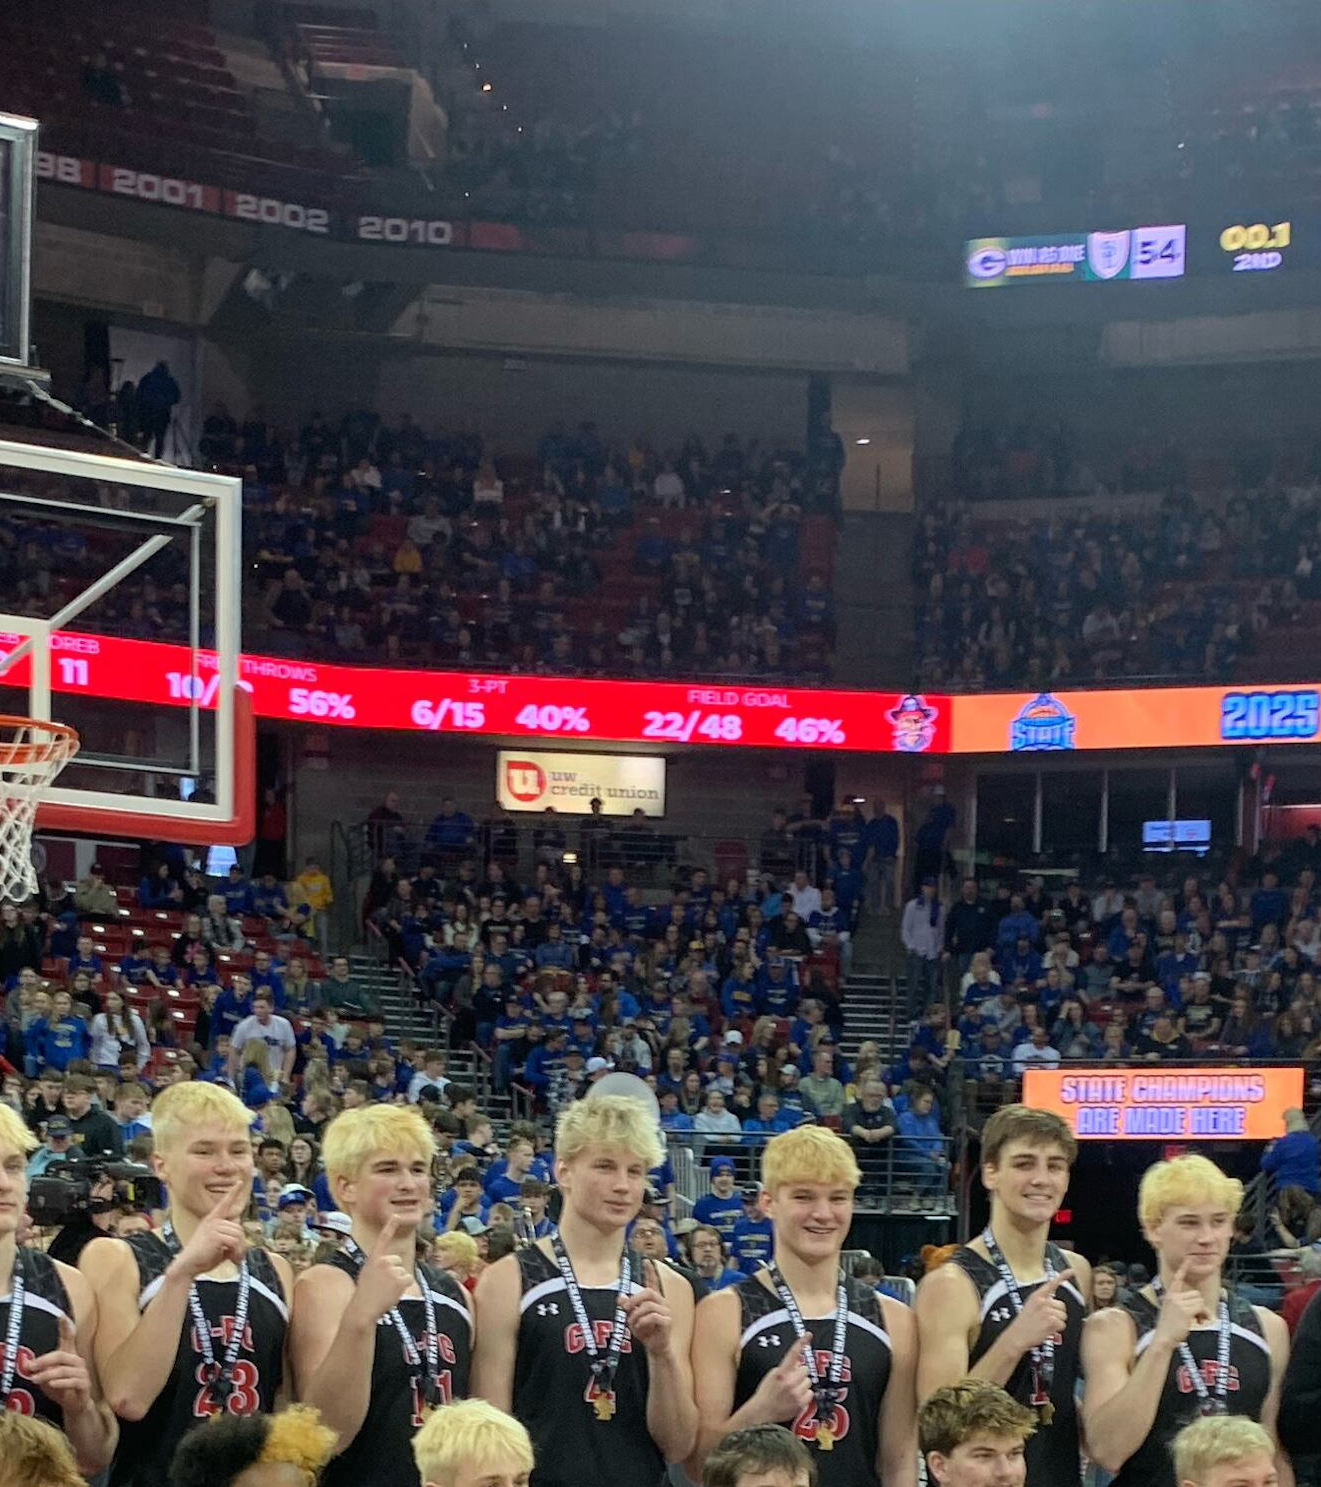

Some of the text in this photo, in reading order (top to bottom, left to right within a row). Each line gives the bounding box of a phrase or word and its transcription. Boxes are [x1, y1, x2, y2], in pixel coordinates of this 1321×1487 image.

[111, 167, 205, 209] 2001
[235, 195, 330, 233] 2002
[358, 215, 453, 245] 2010
[1134, 238, 1179, 265] 54
[57, 657, 89, 686] 11
[243, 658, 319, 683] THROWS
[467, 679, 509, 694] 3-PT
[687, 689, 793, 709] FIELD GOAL
[288, 687, 356, 720] 56%
[410, 698, 591, 732] 6/15 40%
[1220, 689, 1321, 740] 2025
[642, 709, 846, 744] 22/48 46%
[550, 769, 578, 782] uw
[550, 783, 660, 800] credit union
[1060, 1073, 1266, 1104] STATE CHAMPIONS
[1076, 1105, 1247, 1136] ARE MADE HERE
[6, 1274, 25, 1360] CHAMPIONSHIPS
